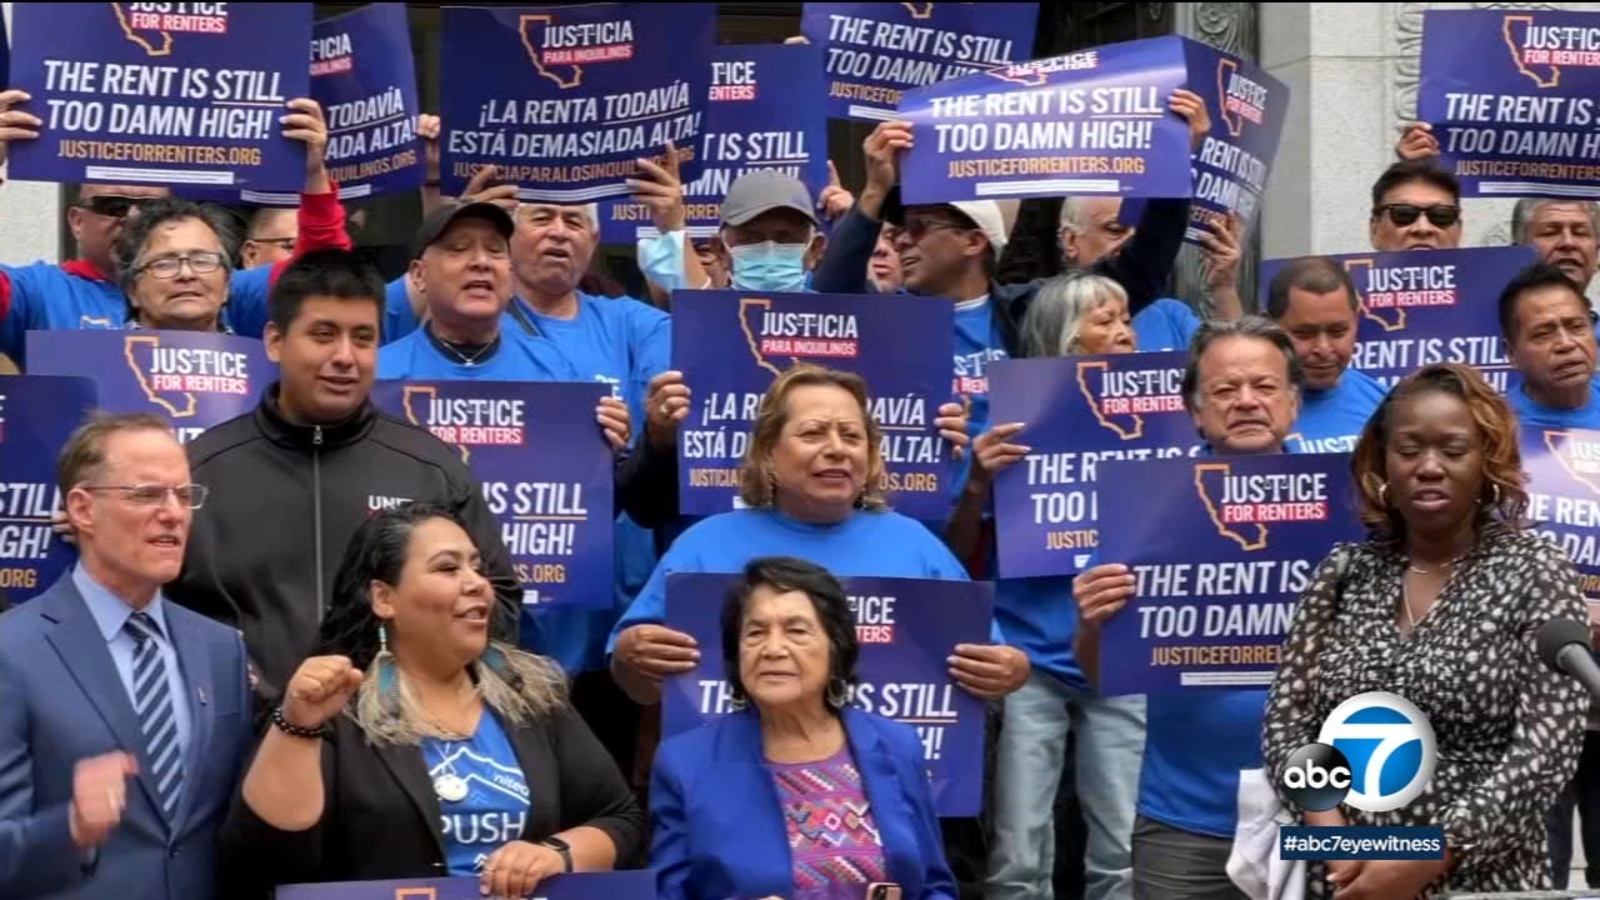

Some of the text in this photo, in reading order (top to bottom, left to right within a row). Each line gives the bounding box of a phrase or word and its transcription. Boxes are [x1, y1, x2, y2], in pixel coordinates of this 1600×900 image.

[132, 12, 226, 33] FOR RENTERS
[541, 21, 634, 49] JUSTICIA
[829, 14, 1013, 65] THE RENT IS STILL
[543, 49, 572, 65] PARA
[826, 49, 871, 77] TOO
[871, 55, 941, 86] DAMN
[1524, 50, 1550, 64] FOR
[44, 60, 285, 103] THE RENT IS STILL
[328, 86, 404, 129] TODAVÍA
[479, 80, 690, 128] ¡LA RENTA TODAVÍA
[930, 86, 1163, 117] THE RENT IS STILL
[1445, 93, 1594, 126] THE RENT IS
[47, 100, 274, 139] TOO DAMN HIGH!
[370, 116, 417, 153] ALTA!
[448, 128, 506, 156] ESTÁ
[512, 126, 645, 159] DEMASIADA
[650, 111, 702, 148] ALTA!
[57, 139, 262, 166] JUSTICEFORRENTERS.ORG
[718, 133, 741, 161] IS
[745, 131, 810, 161] STILL
[935, 120, 1152, 153] TOO DAMN HIGH!
[1446, 128, 1496, 153] TOO
[1500, 129, 1578, 157] DAMN
[947, 156, 1145, 178] JUSTICEFORRENTERS.ORG
[1200, 137, 1240, 173] RENT
[1366, 265, 1456, 292] JUSTICE
[1369, 290, 1455, 308] FOR RENTERS
[761, 311, 858, 339] JUSTICIA
[150, 348, 249, 378] JUSTICE
[762, 339, 856, 356] PARA INQUILINOS
[1348, 336, 1510, 369] RENT IS STIL
[153, 375, 247, 394] FOR RENTERS
[427, 398, 525, 427] JUSTICE
[702, 392, 737, 426] ¡LA
[1104, 398, 1130, 414] FOR
[460, 427, 522, 444] RENTERS
[684, 426, 727, 458] ESTÁ
[880, 435, 943, 463] ALTA!
[1025, 453, 1076, 485] THE
[513, 482, 587, 515] STILL
[1221, 473, 1328, 503] JUSTICE
[1031, 491, 1085, 524] TOO
[1224, 502, 1325, 523] FOR RENTERS
[502, 523, 575, 556] HIGH!
[1133, 559, 1310, 597] THE RENT IS
[1138, 602, 1295, 638] TOO DAMN
[879, 683, 958, 717] STILL
